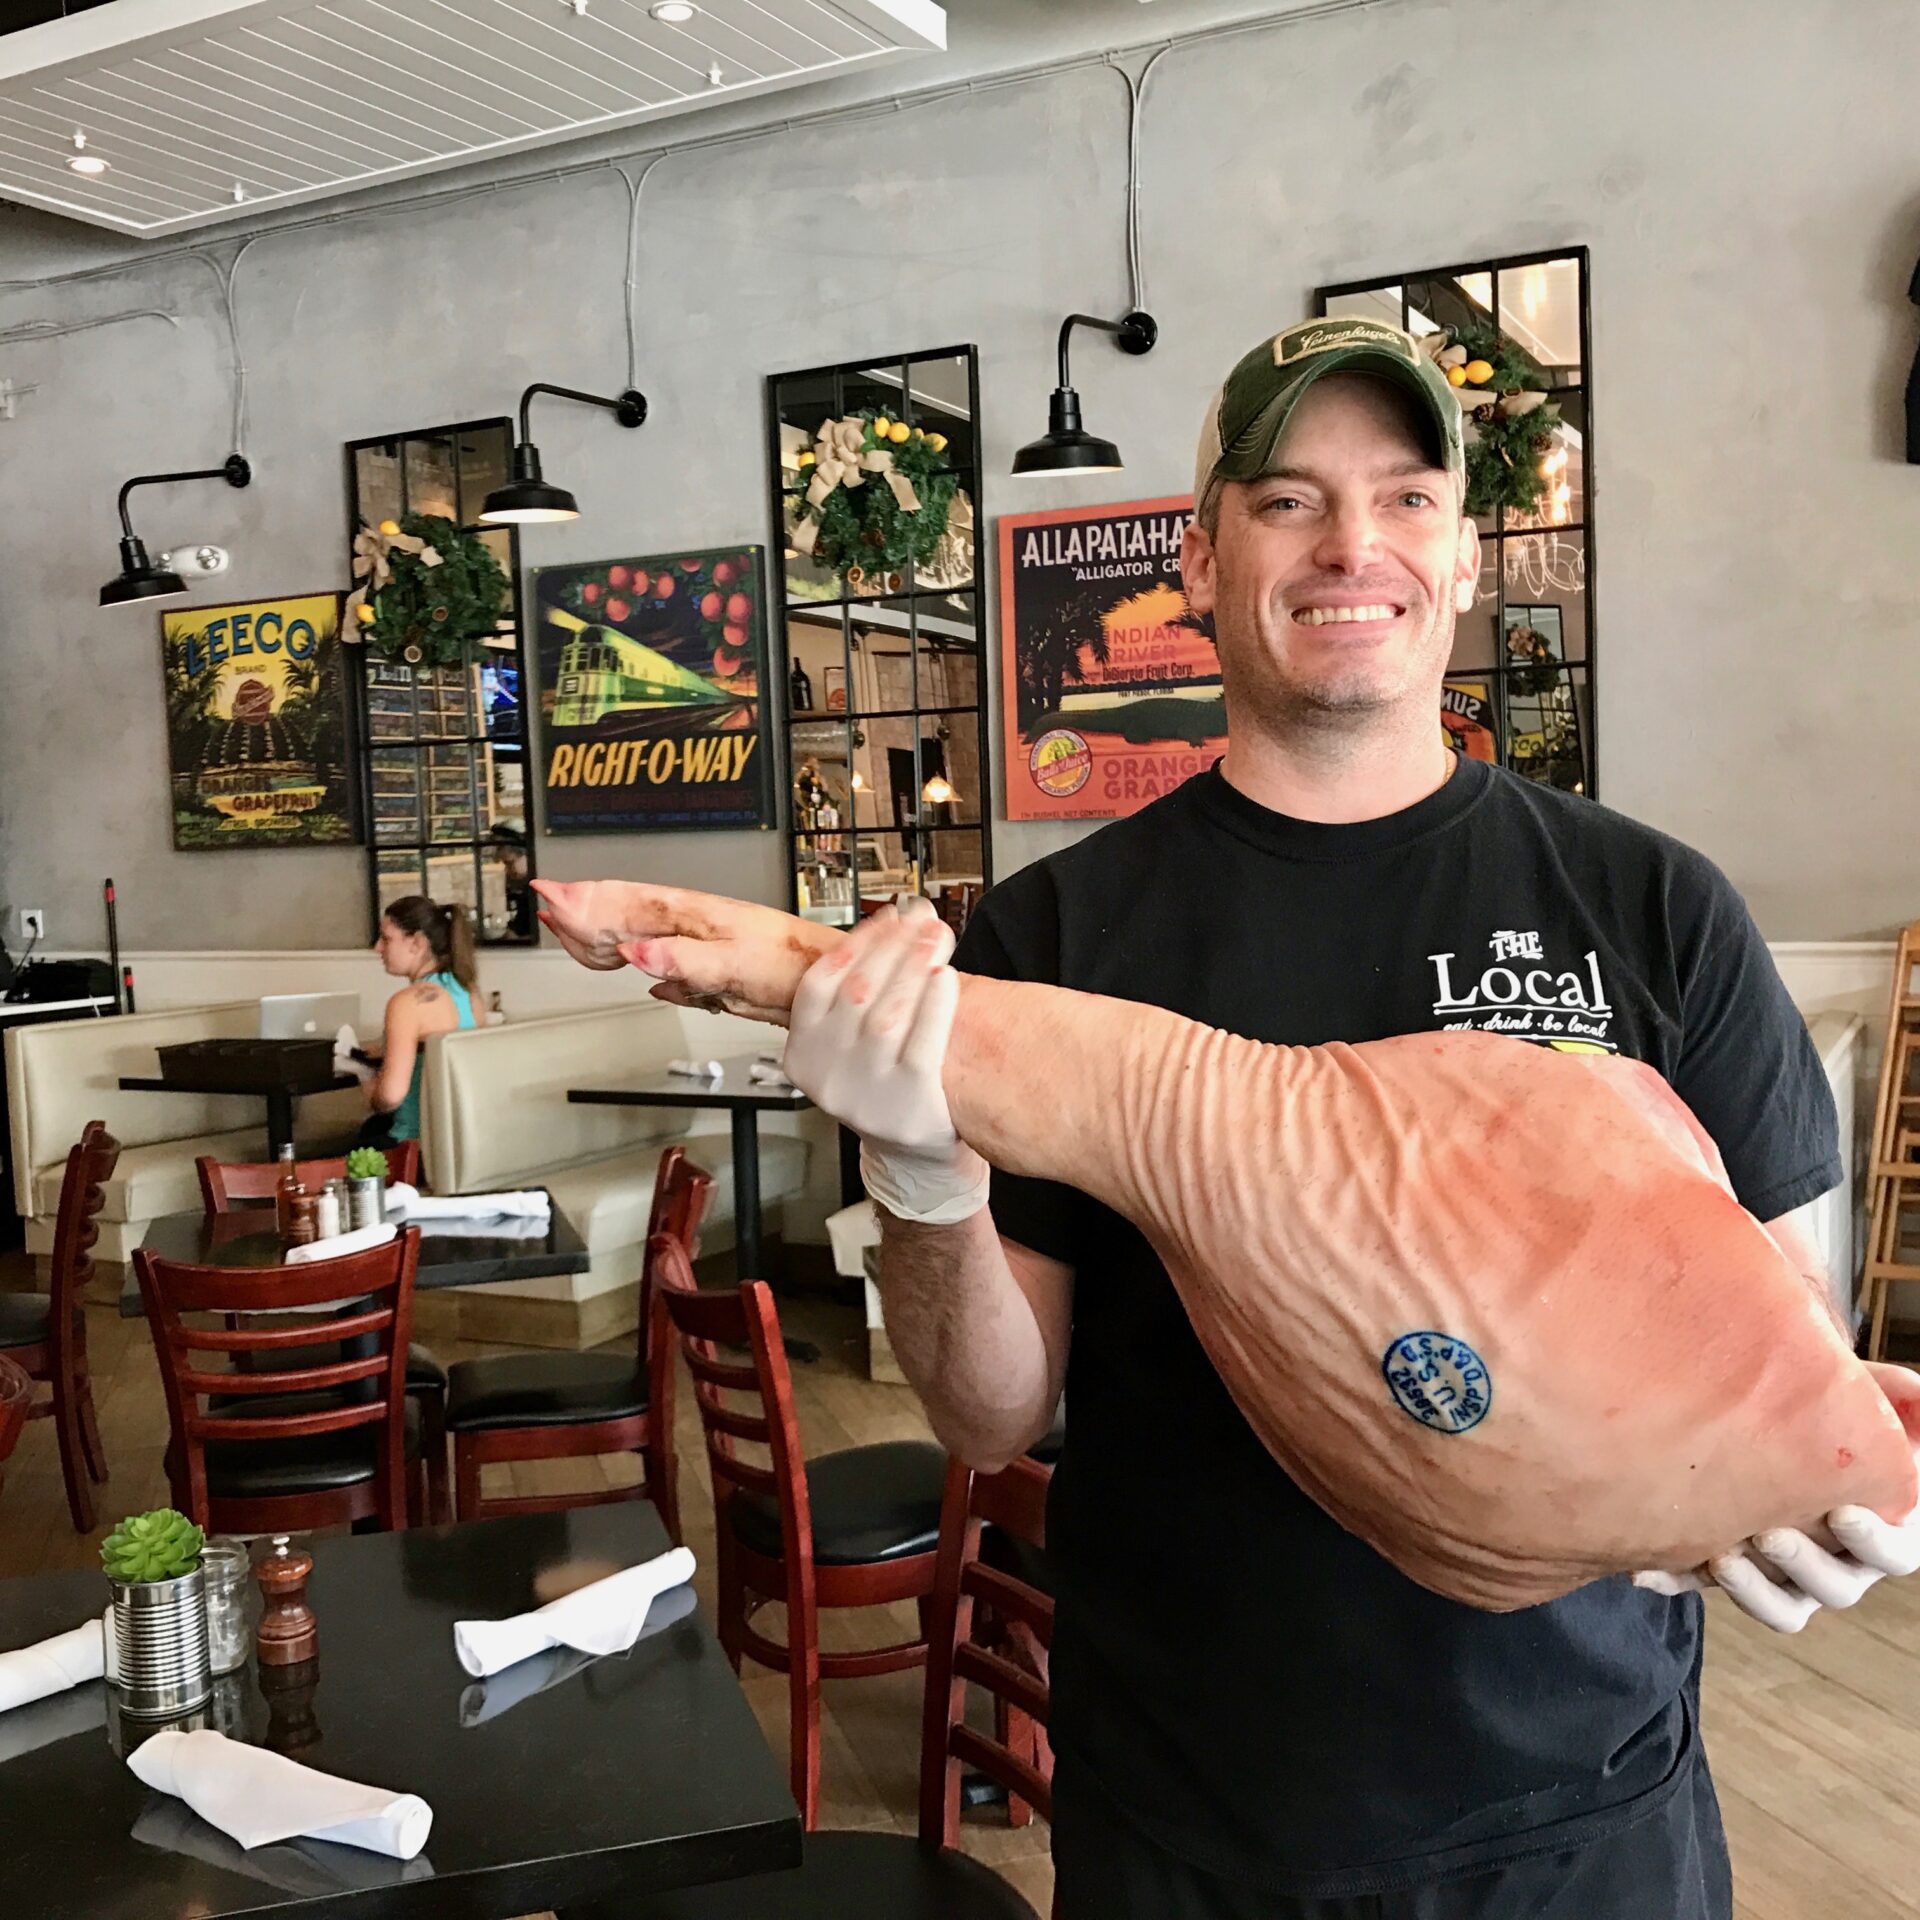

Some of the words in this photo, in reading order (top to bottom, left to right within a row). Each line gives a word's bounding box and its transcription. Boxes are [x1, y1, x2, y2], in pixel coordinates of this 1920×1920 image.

[186, 611, 316, 676] LEECO
[547, 734, 758, 788] RIGHT-O-WAY
[1489, 930, 1544, 962] THE
[1483, 1012, 1534, 1031] drink
[1542, 1013, 1564, 1031] be
[1568, 1014, 1608, 1038] local
